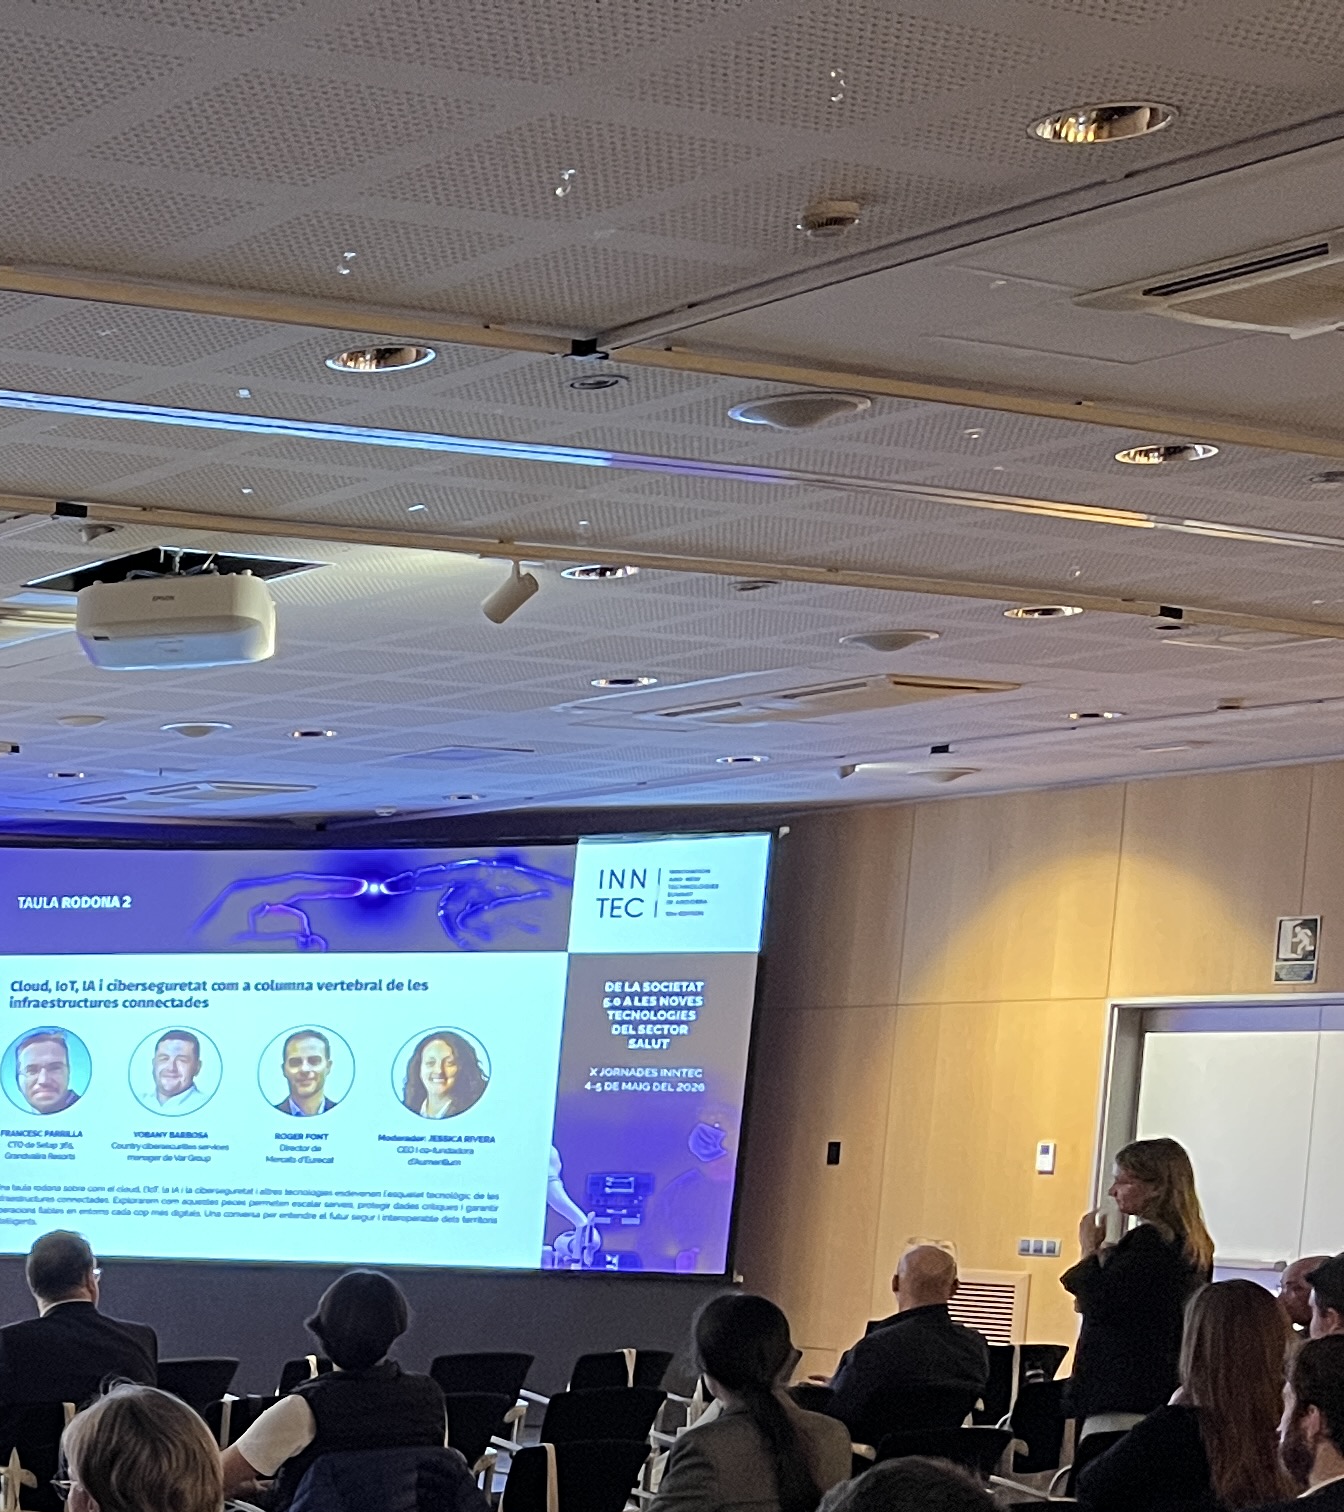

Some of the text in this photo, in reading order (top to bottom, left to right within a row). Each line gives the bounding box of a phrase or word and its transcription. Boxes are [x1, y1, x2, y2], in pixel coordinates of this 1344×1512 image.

[599, 868, 647, 890] INN
[18, 895, 132, 909] TAULA RODONA 2
[596, 897, 645, 918] TEC
[10, 978, 429, 995] Cloud, IoT, IA i ciberseguretat com a columna vertebral de les
[604, 981, 705, 993] DE LA SOCIETAT
[9, 995, 210, 1009] infraestructures connectades
[622, 997, 632, 1006] A
[633, 996, 657, 1007] LES
[659, 996, 705, 1007] NOVES
[606, 1010, 697, 1021] TECNOLOGIES
[611, 1024, 689, 1035] DEL SECTOR
[627, 1038, 671, 1049] SALUT
[589, 1067, 703, 1078] X JORNADES INNTEC
[604, 1082, 619, 1091] DE
[621, 1082, 651, 1091] MAIG
[652, 1082, 674, 1091] DEL
